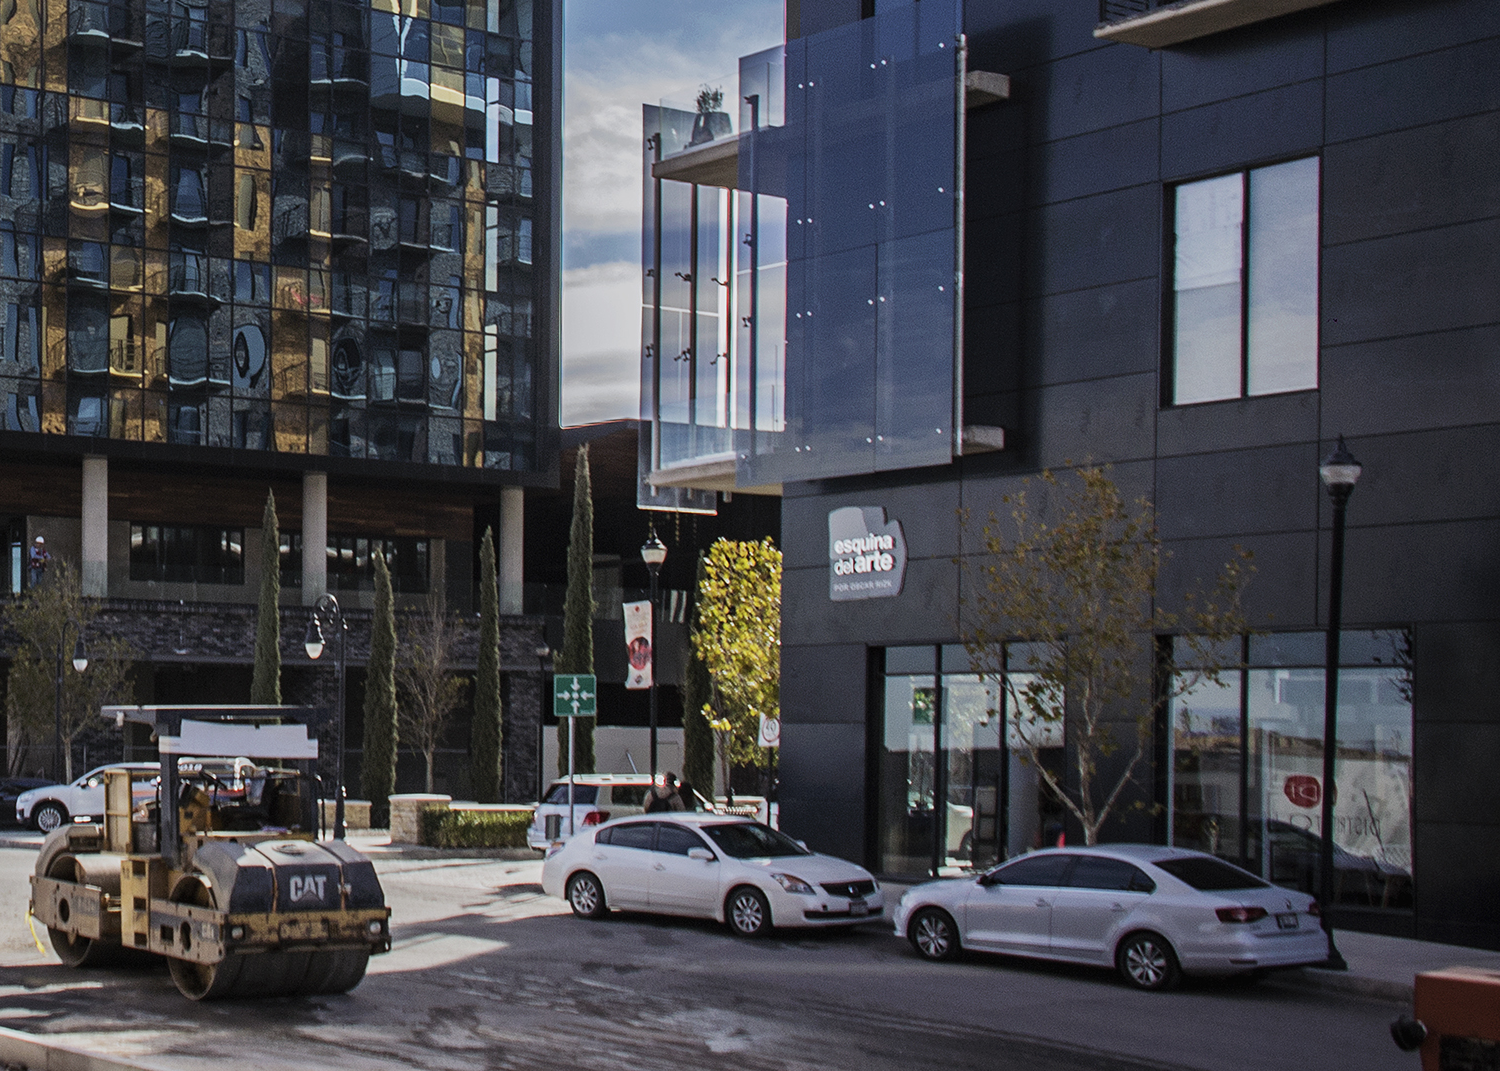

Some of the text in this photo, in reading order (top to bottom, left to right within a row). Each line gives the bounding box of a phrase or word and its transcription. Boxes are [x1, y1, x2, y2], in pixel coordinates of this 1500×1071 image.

[833, 533, 894, 556] esquina
[833, 550, 894, 576] del arte
[289, 876, 327, 903] CAT
